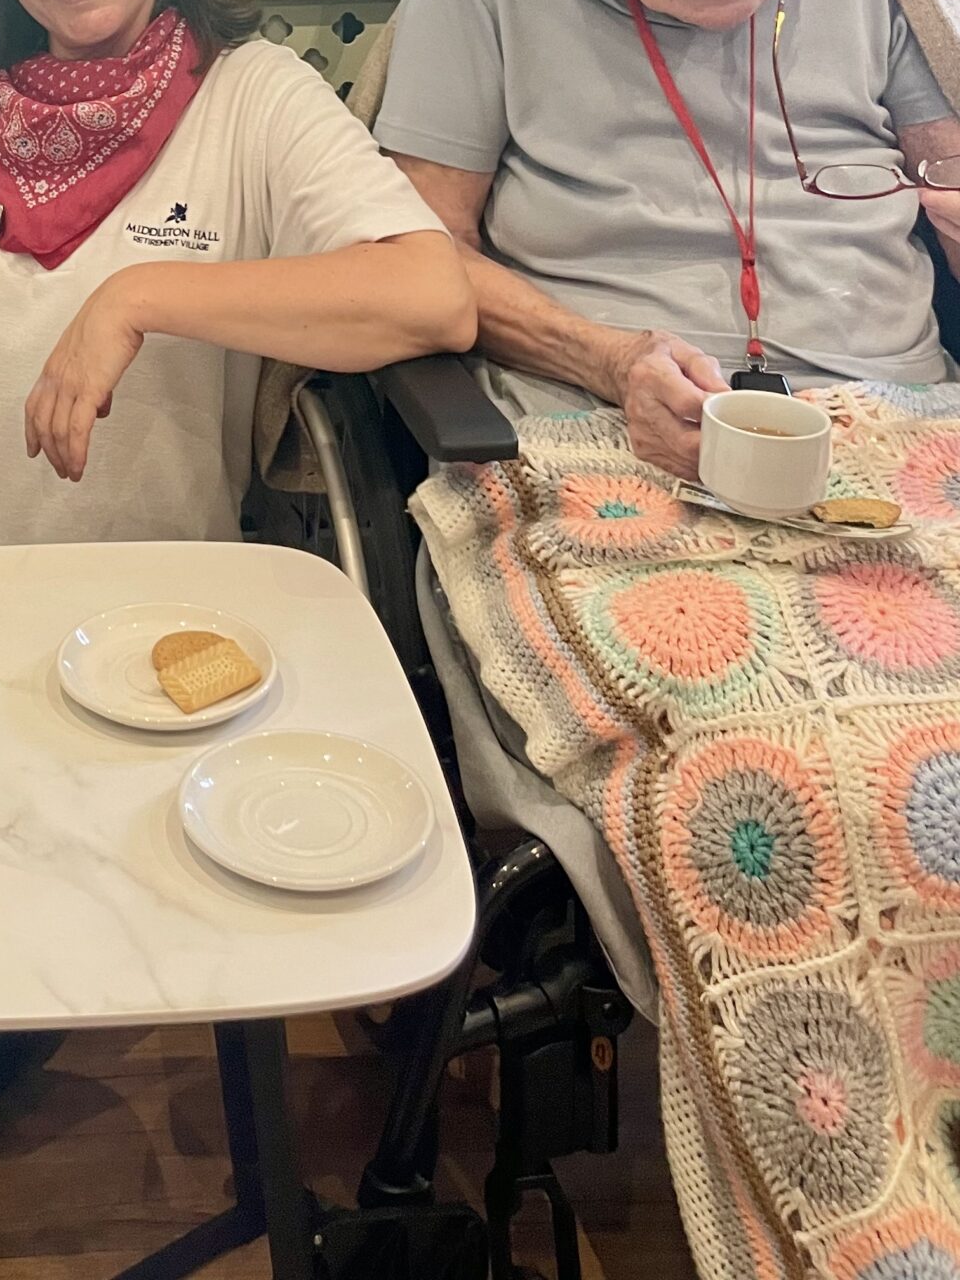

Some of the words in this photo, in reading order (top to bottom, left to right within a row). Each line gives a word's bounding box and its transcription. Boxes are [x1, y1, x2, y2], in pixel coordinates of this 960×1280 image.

[126, 222, 190, 238] MIDDLETON
[193, 229, 220, 242] HALL
[133, 235, 180, 247] RETIREMENT
[180, 240, 210, 251] VILLAGE
